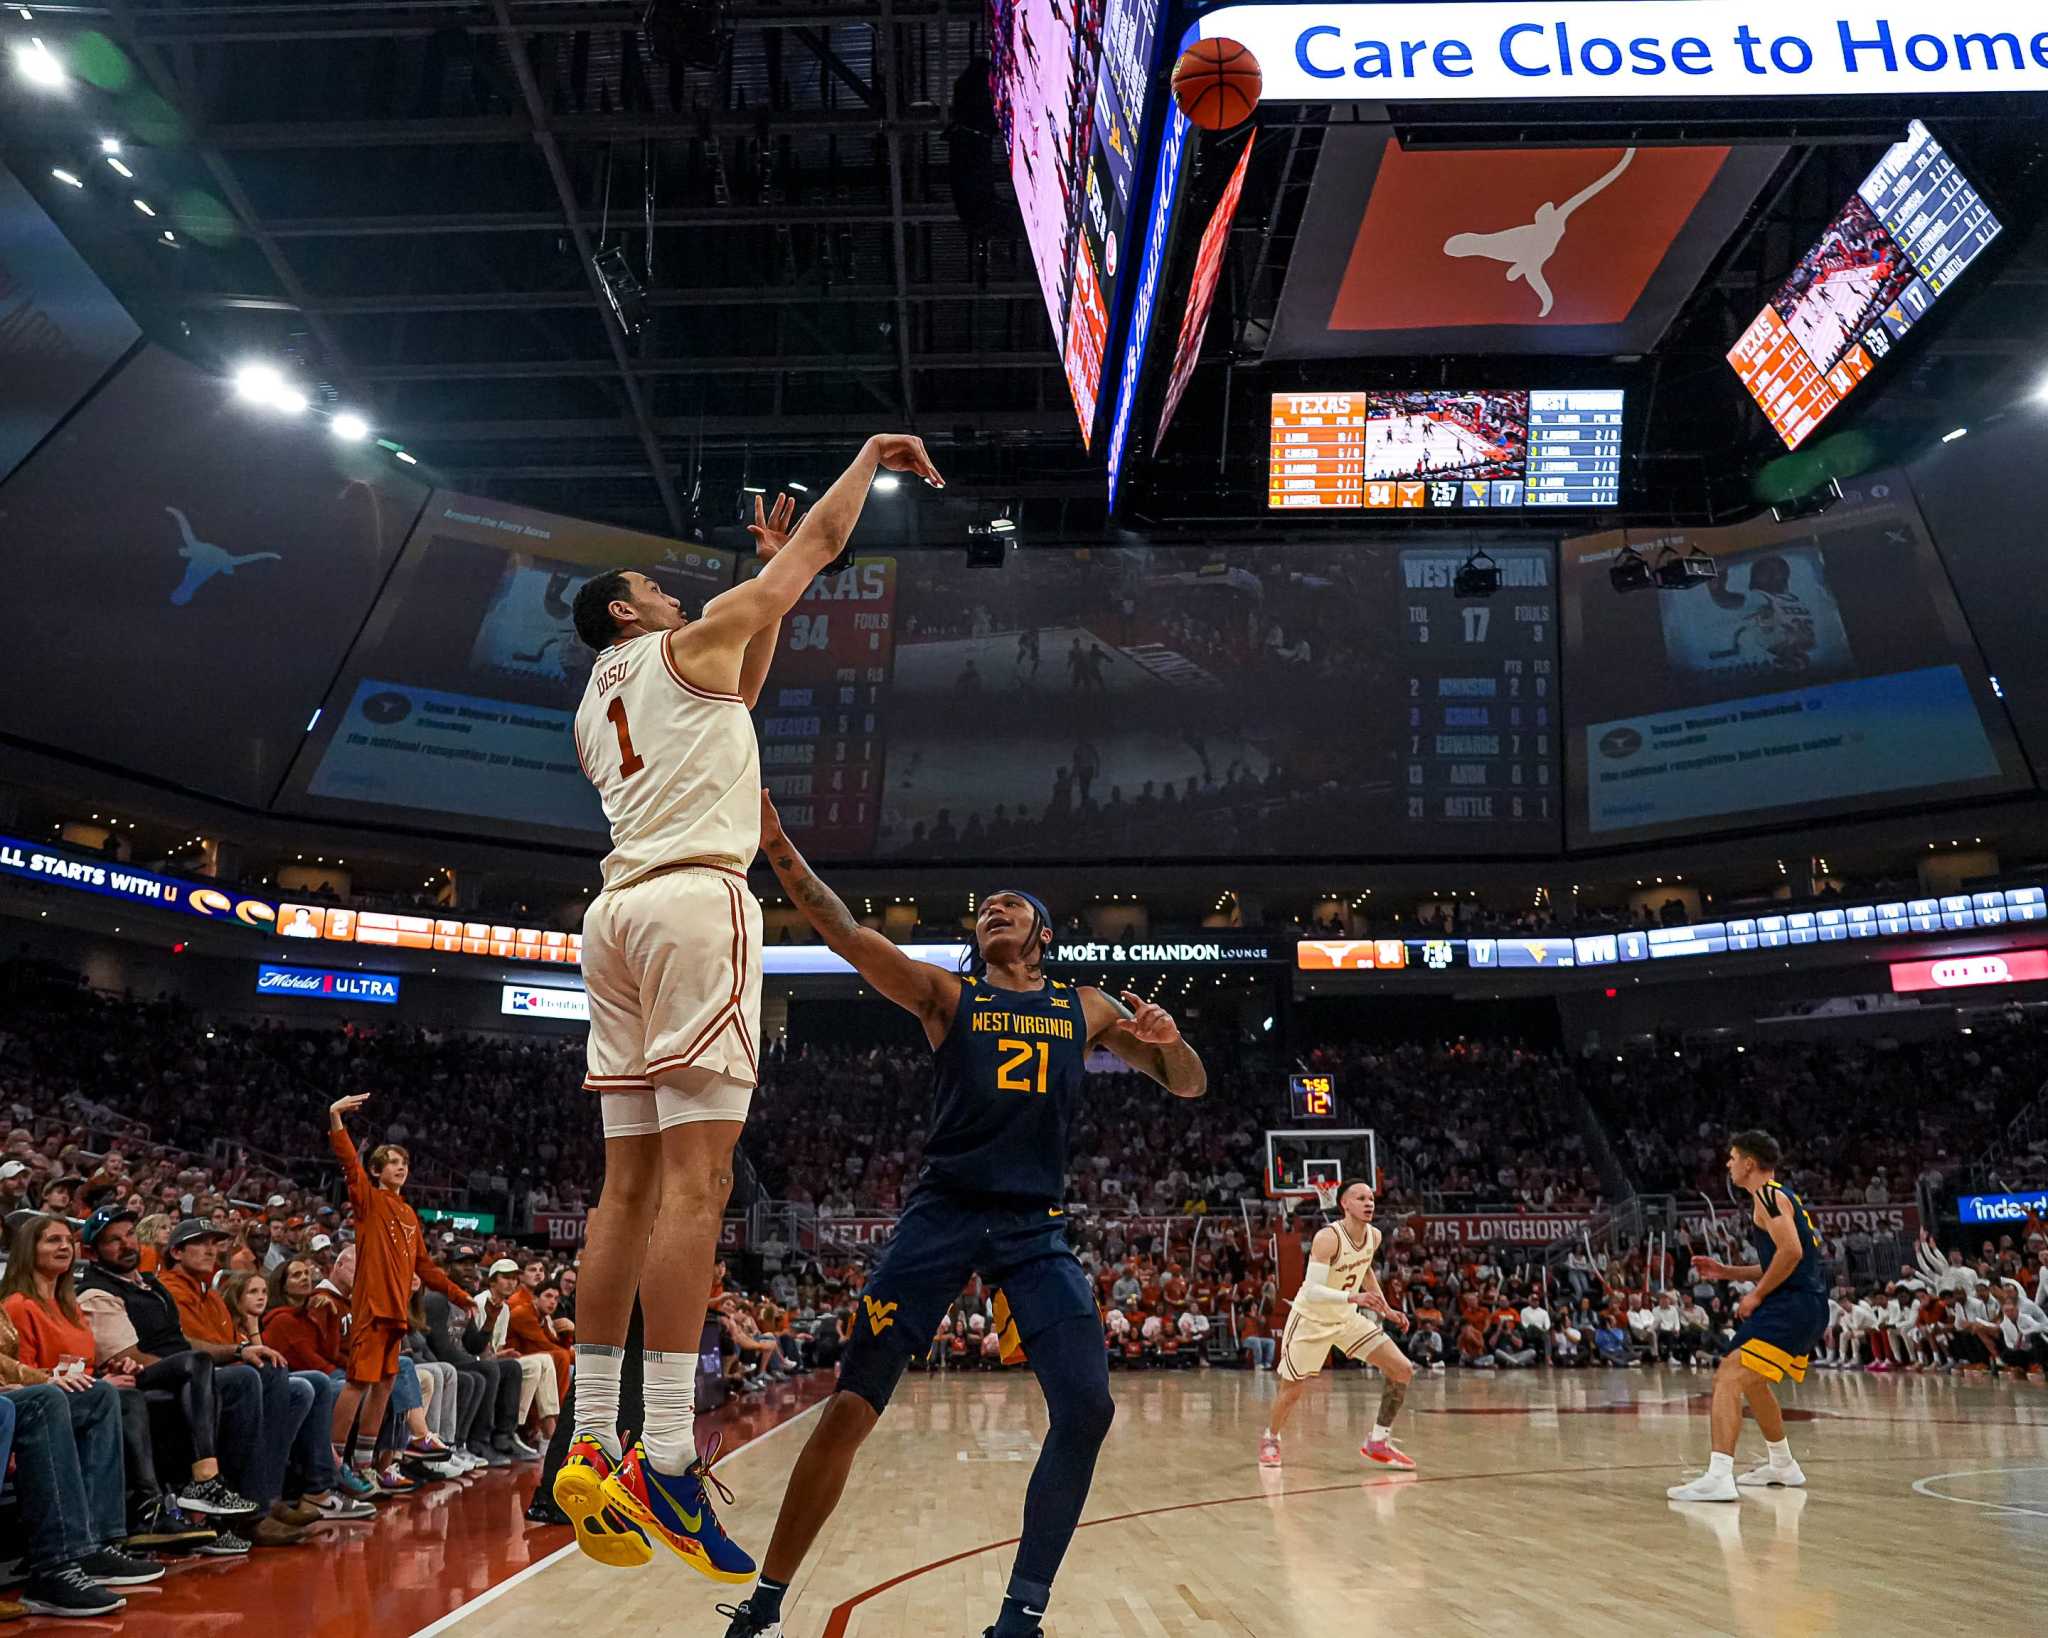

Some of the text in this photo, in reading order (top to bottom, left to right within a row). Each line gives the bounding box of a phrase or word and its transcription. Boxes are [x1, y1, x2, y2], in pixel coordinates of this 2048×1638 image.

[1295, 19, 2048, 79] Care Close to Home
[1735, 317, 1774, 364] TEXAS
[1288, 396, 1351, 414] TEXAS
[1369, 486, 1389, 505] 34
[1500, 484, 1516, 504] 17
[803, 562, 885, 600] XAS
[790, 614, 829, 652] 34
[1462, 607, 1490, 643] 17
[597, 661, 629, 698] DISU
[1410, 678, 1420, 697] 2
[607, 696, 645, 780] 1
[0, 846, 26, 868] LL
[30, 855, 106, 886] STARTS
[111, 871, 161, 899] WITH
[1058, 942, 1111, 961] MOËT
[1112, 944, 1127, 961] &
[1129, 943, 1220, 961] CHANDON
[1221, 947, 1268, 959] LOUNGE
[258, 971, 397, 997] Michelob ULTRA
[539, 996, 585, 1012] Frontier
[972, 1012, 1074, 1040] WEST VIRGINIA
[997, 1039, 1050, 1094] 21
[1307, 1092, 1327, 1113] 12
[1975, 1194, 2047, 1219] indeed
[548, 1219, 587, 1240] HOO
[1466, 1219, 1590, 1242] LONGHORNS
